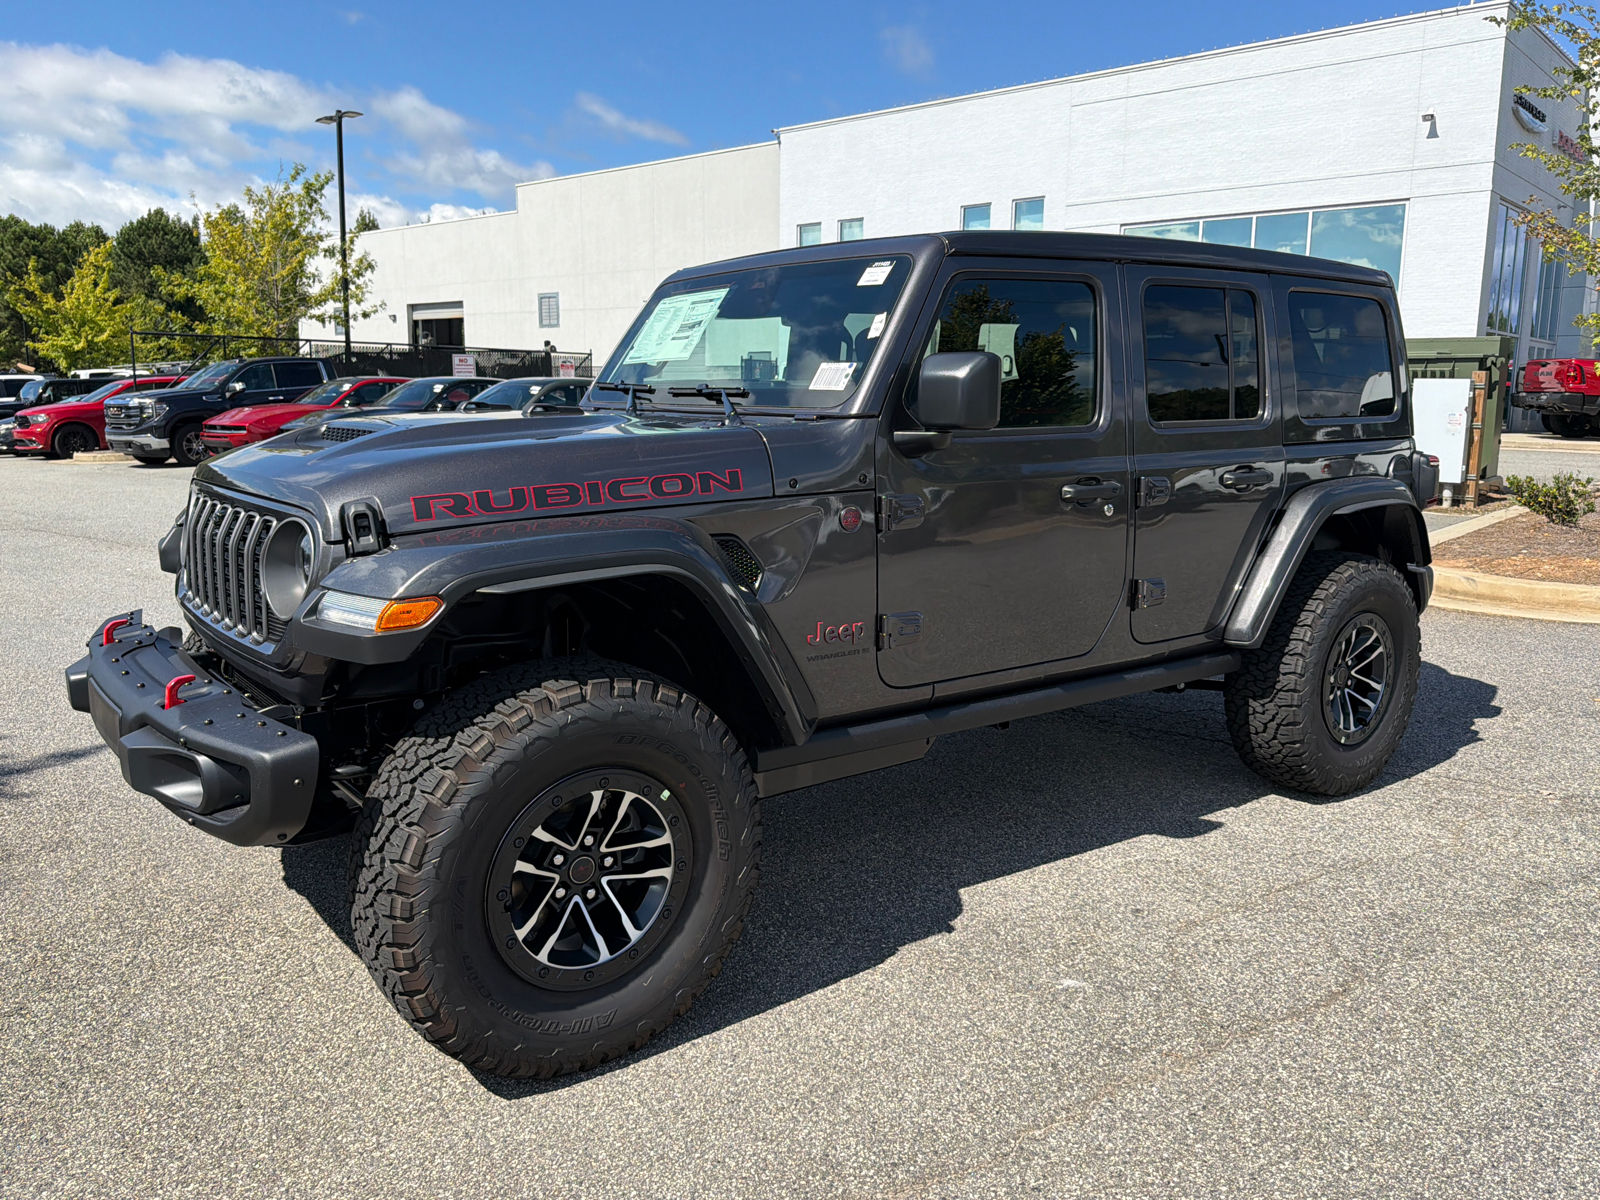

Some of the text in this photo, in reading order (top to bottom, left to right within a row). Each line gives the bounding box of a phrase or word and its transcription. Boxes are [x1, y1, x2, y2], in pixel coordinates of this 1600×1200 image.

[410, 469, 743, 521] RUBICON
[807, 621, 865, 646] Jeep
[806, 649, 860, 662] WRANGLER
[614, 734, 731, 861] BFGoodrich
